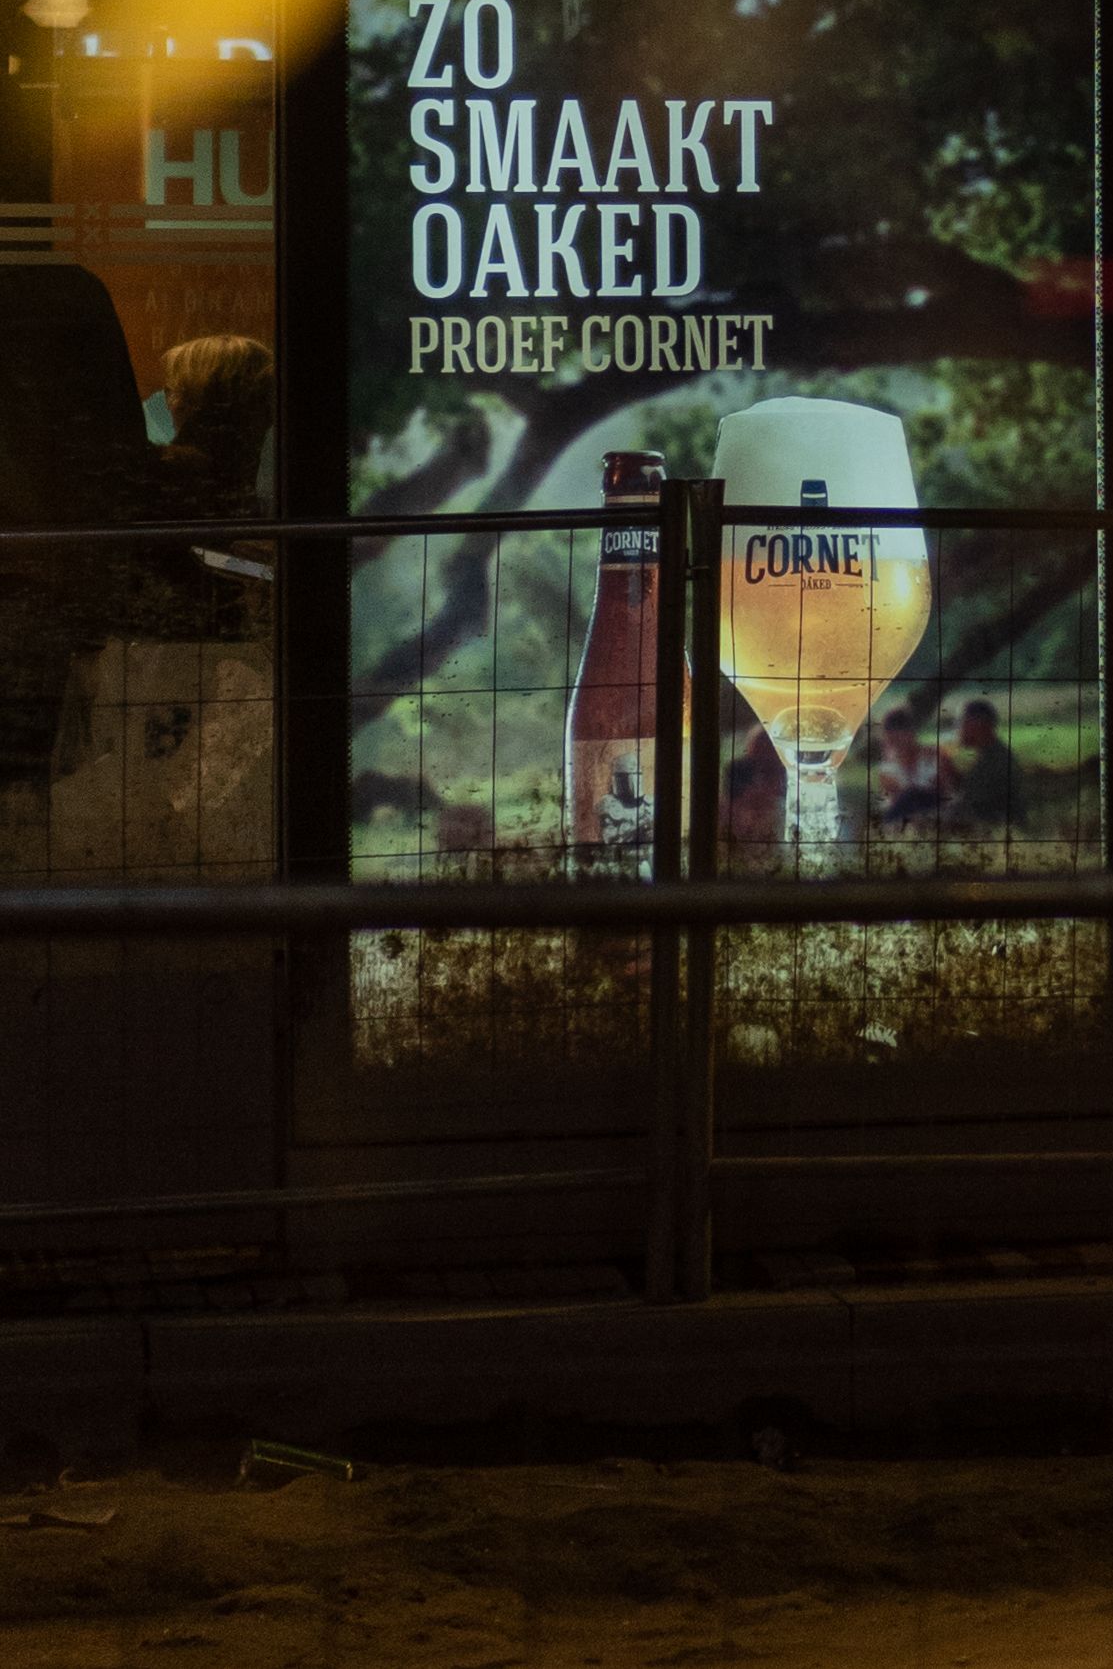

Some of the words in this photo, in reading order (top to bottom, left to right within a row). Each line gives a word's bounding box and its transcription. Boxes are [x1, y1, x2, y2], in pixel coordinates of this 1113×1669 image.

[409, 99, 773, 194] SMAAKT
[412, 203, 701, 298] OAKED
[408, 316, 568, 373] PROEF
[581, 315, 773, 372] CORNET
[605, 530, 659, 553] CORNET
[745, 534, 880, 584] CORNET
